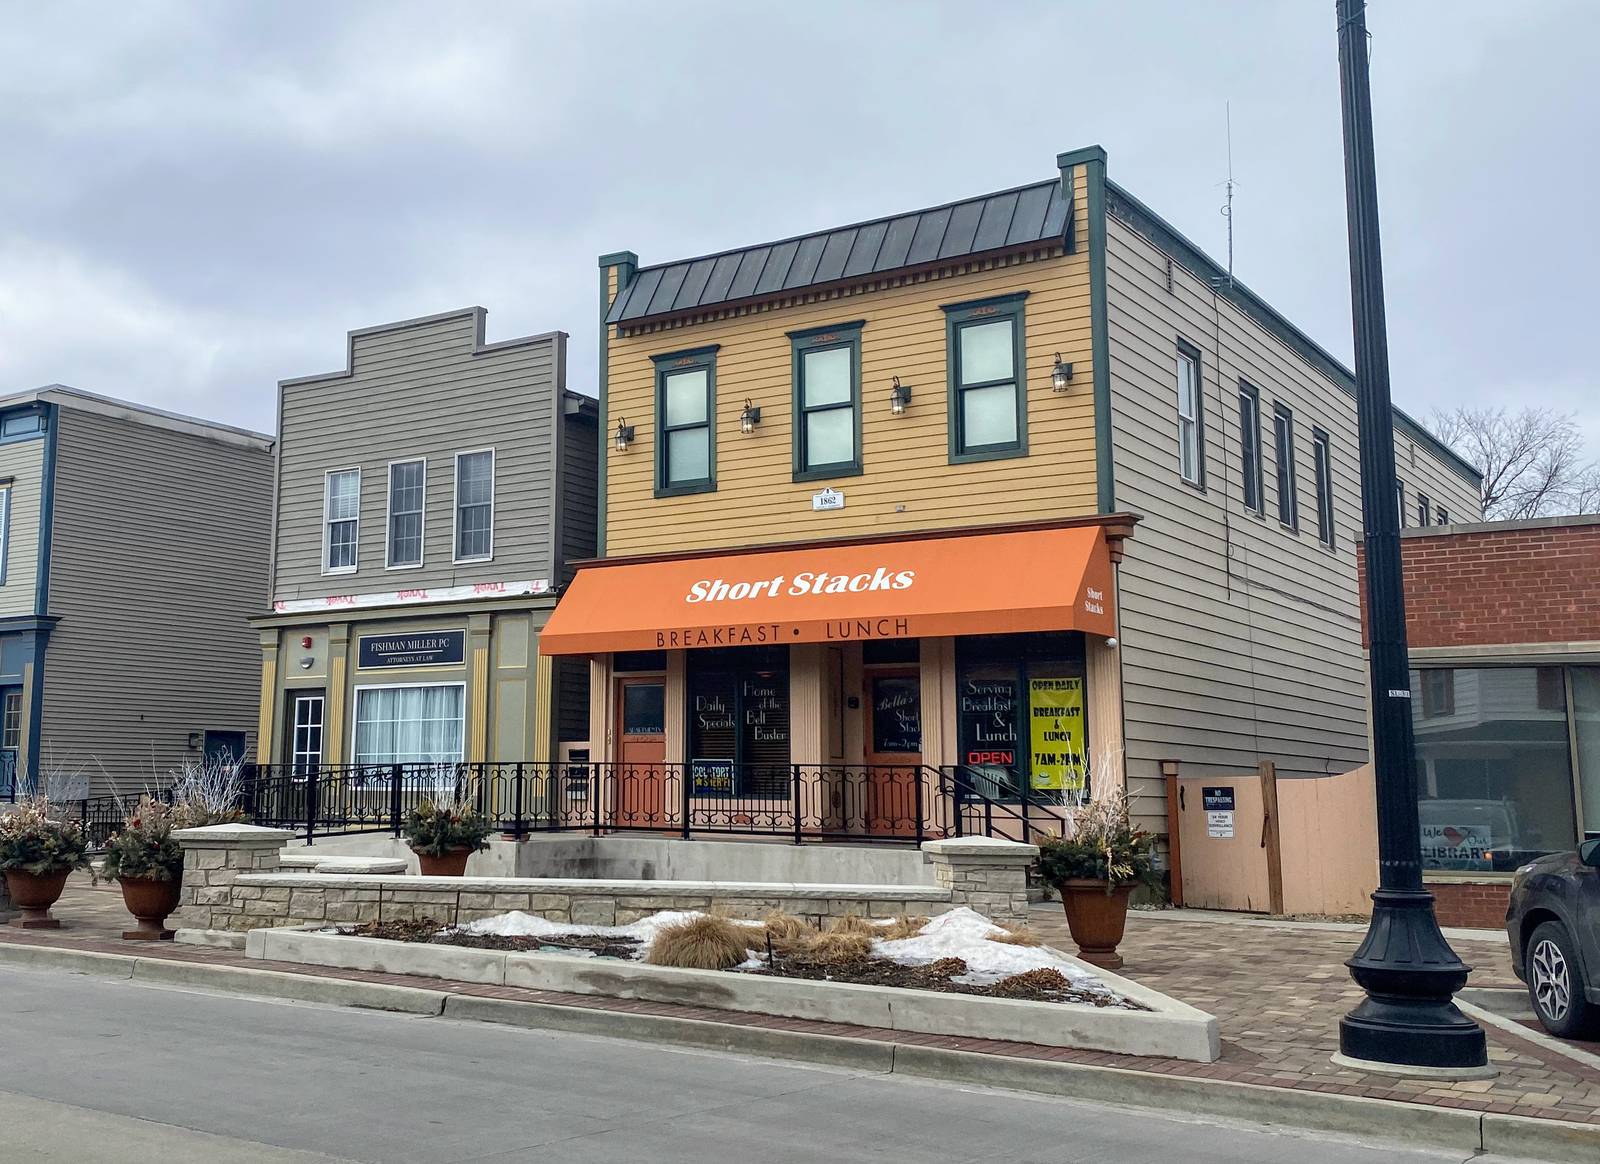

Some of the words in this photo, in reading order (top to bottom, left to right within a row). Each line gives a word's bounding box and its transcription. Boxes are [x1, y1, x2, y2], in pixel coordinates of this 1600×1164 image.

[820, 496, 837, 505] 1862
[685, 577, 785, 603] Short
[788, 567, 916, 596] Stacks
[1086, 586, 1103, 601] Short
[1085, 599, 1104, 615] Stacks
[656, 624, 781, 648] BREAKFAST
[826, 618, 909, 639] LUNCH
[371, 641, 406, 652] FISHMAN
[408, 638, 437, 650] MILLER
[438, 638, 450, 648] PC
[744, 680, 777, 697] Home
[967, 680, 1012, 697] Serving
[1032, 681, 1054, 690] OPEN
[1055, 680, 1080, 690] DAILY
[696, 695, 725, 715] Daily
[962, 696, 1012, 711] Breakfast
[1033, 707, 1080, 717] BREAKFAST
[698, 713, 736, 730] Specials
[993, 712, 1005, 727] &
[755, 726, 786, 740] Buster
[976, 723, 1017, 741] Lunch
[1044, 732, 1071, 741] LUNCH
[968, 752, 1013, 765] OPEN
[1035, 753, 1081, 766] 7AM-2PM
[1215, 789, 1221, 797] NO
[1423, 827, 1443, 839] We
[1421, 847, 1491, 859] LIBRARY
